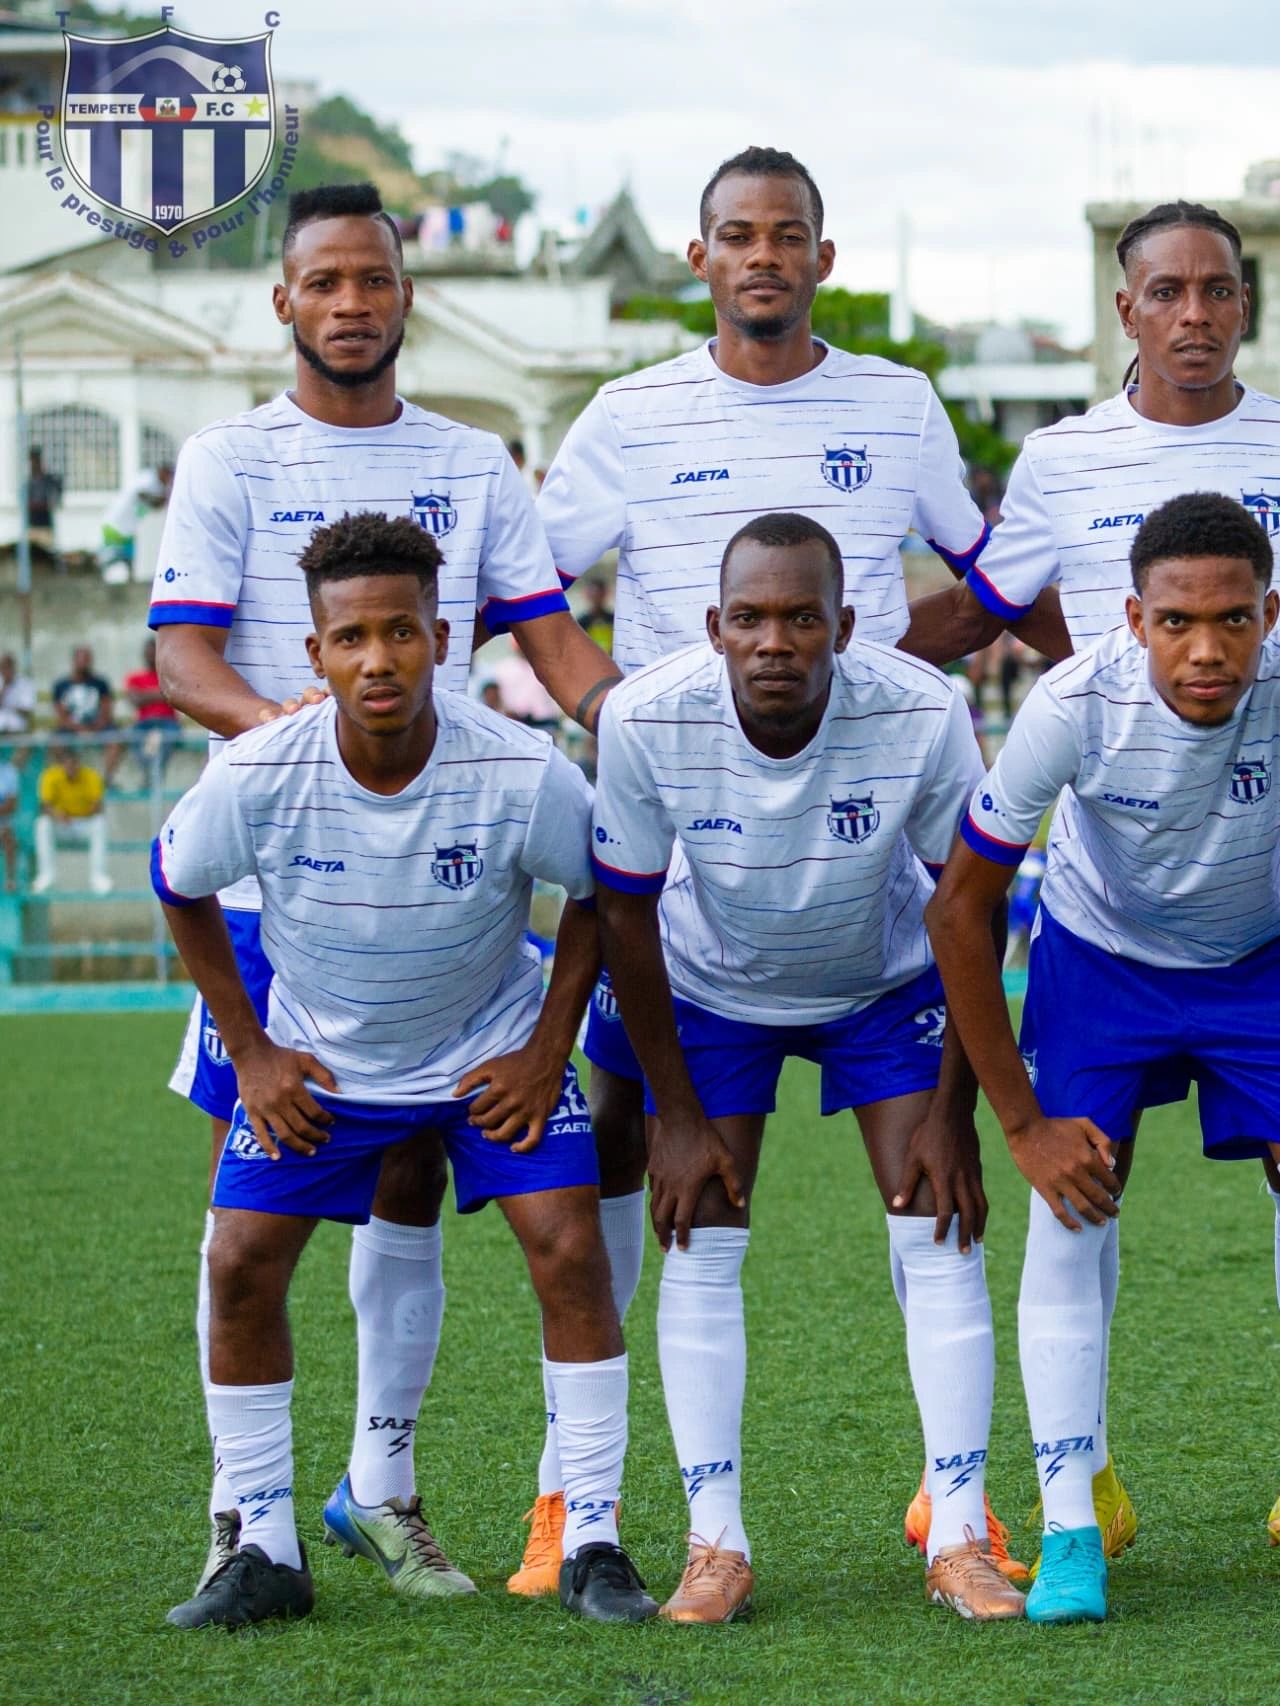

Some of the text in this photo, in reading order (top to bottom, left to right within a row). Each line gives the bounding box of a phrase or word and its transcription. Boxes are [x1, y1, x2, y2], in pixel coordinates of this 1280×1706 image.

[670, 469, 729, 485] SAETA
[270, 511, 325, 522] SAETA
[1088, 513, 1144, 530] SAETA
[1096, 793, 1159, 810] SAETA
[686, 818, 742, 835] SAETA
[288, 855, 345, 872] SAETA
[935, 1449, 987, 1472] SAET
